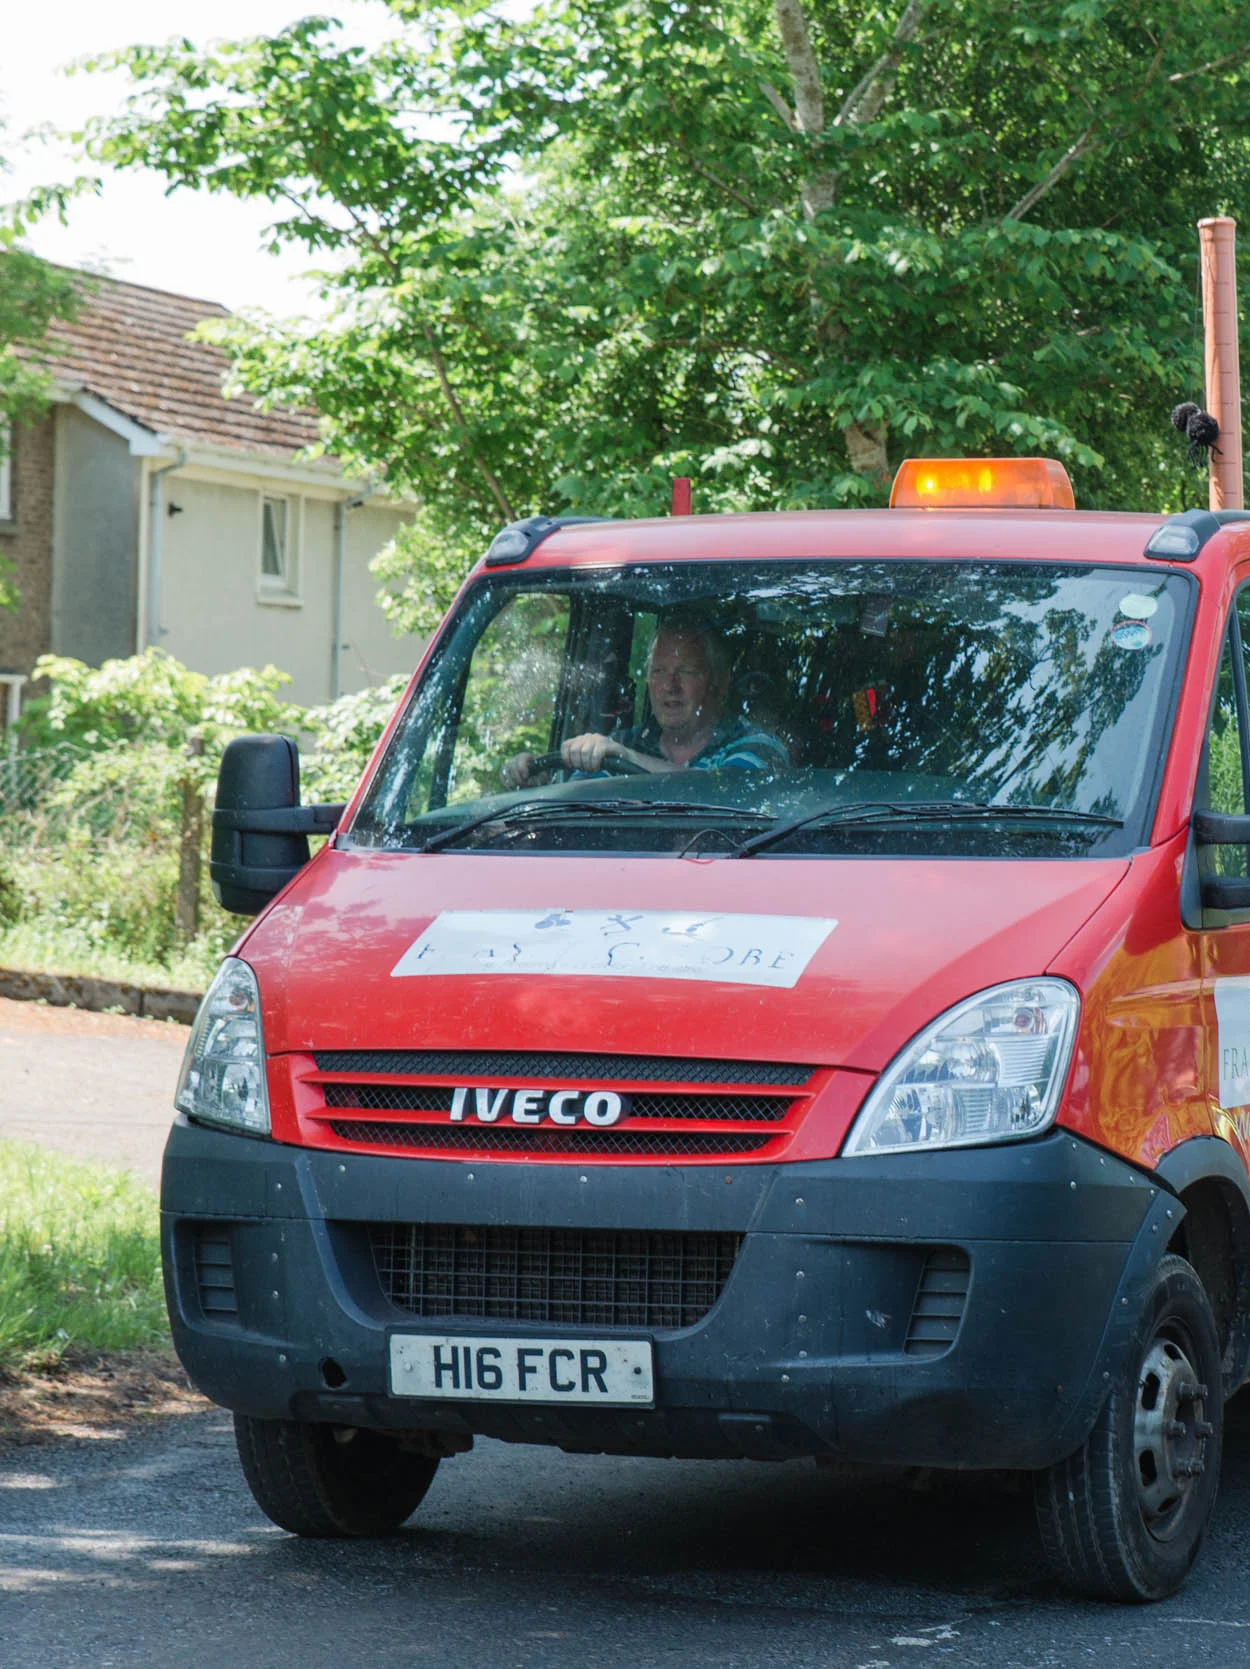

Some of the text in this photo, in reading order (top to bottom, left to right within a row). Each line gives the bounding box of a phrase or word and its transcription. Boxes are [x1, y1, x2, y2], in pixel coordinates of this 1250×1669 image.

[449, 1086, 622, 1127] IVECO
[433, 1344, 609, 1393] H16 FCR
